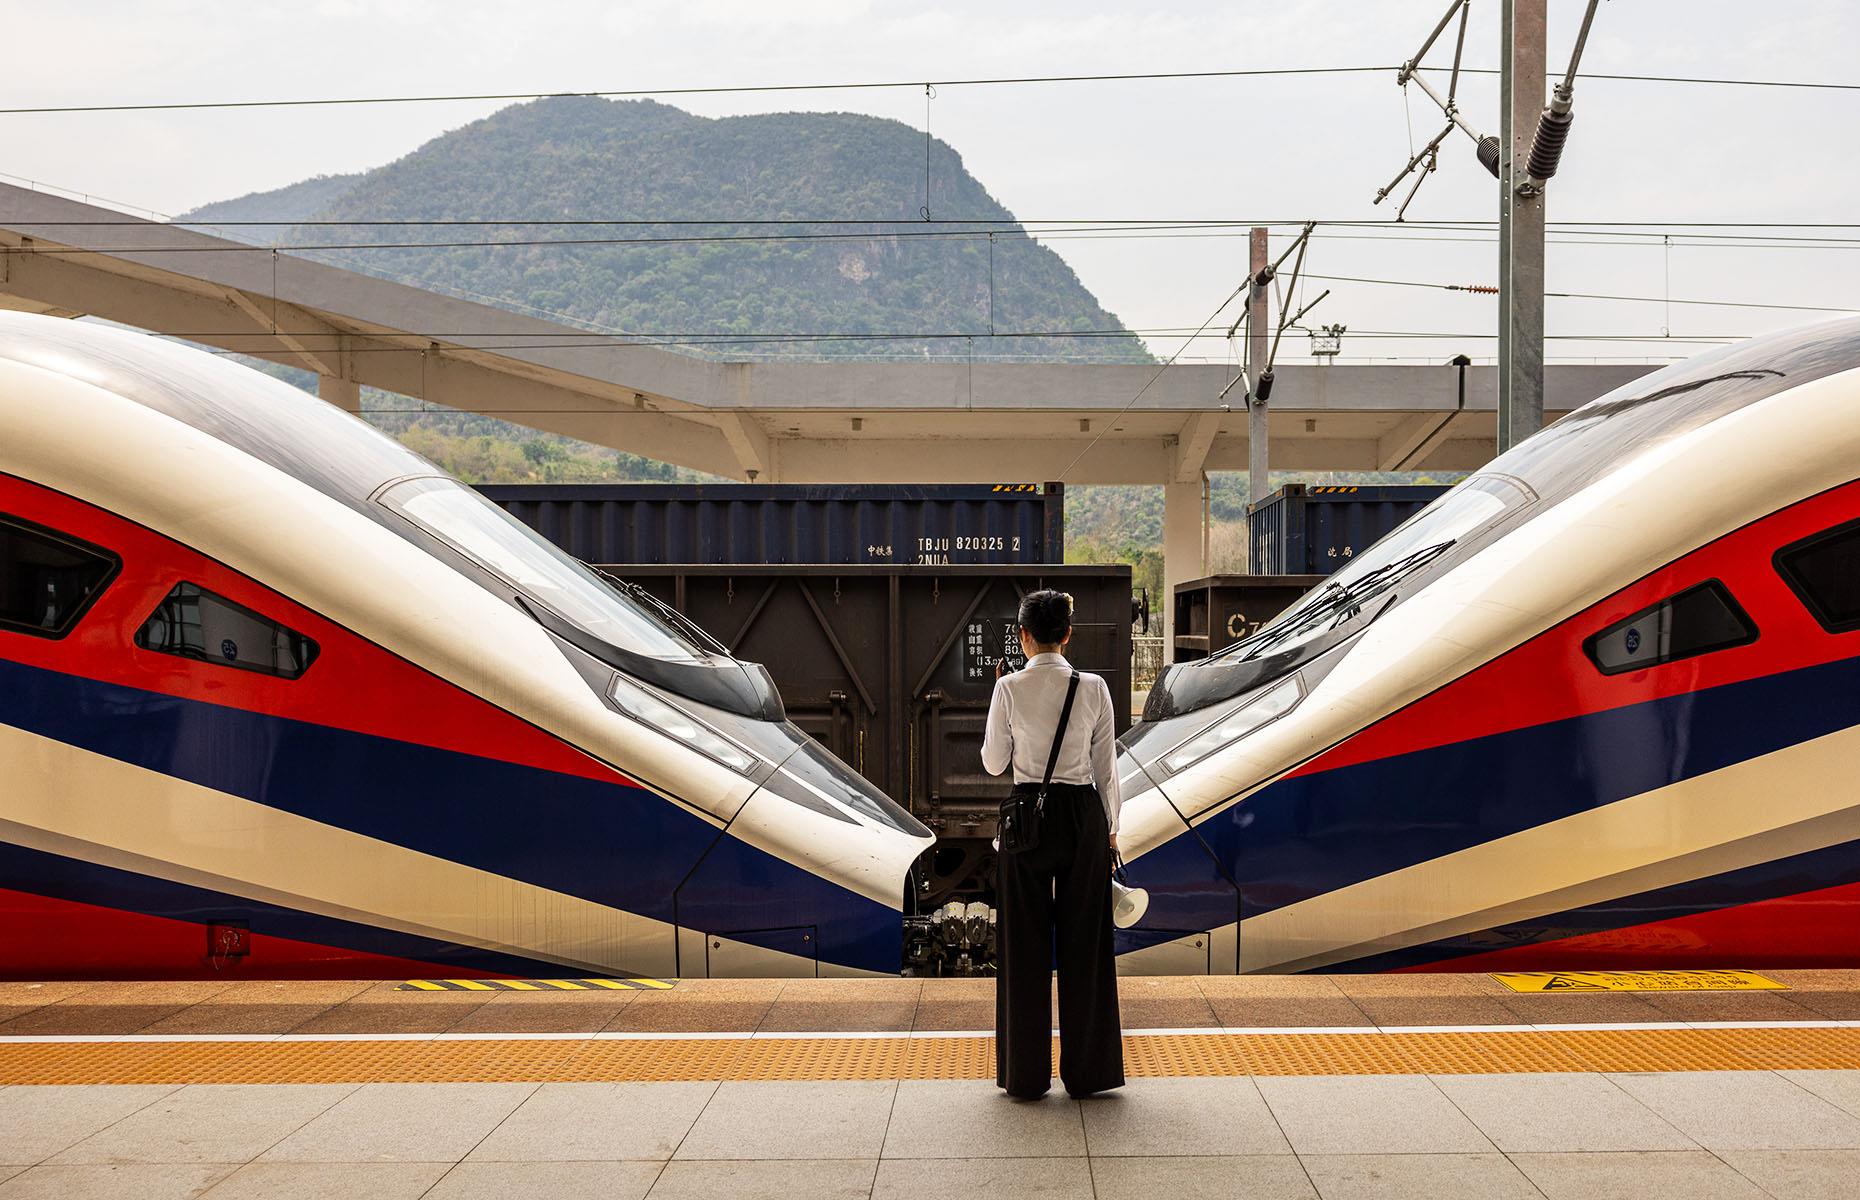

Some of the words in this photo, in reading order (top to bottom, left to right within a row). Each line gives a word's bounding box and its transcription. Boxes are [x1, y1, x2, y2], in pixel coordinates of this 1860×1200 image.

[918, 538, 949, 551] TBJU
[956, 537, 1003, 551] 820325
[1012, 537, 1020, 551] 2
[1227, 613, 1267, 638] C7
